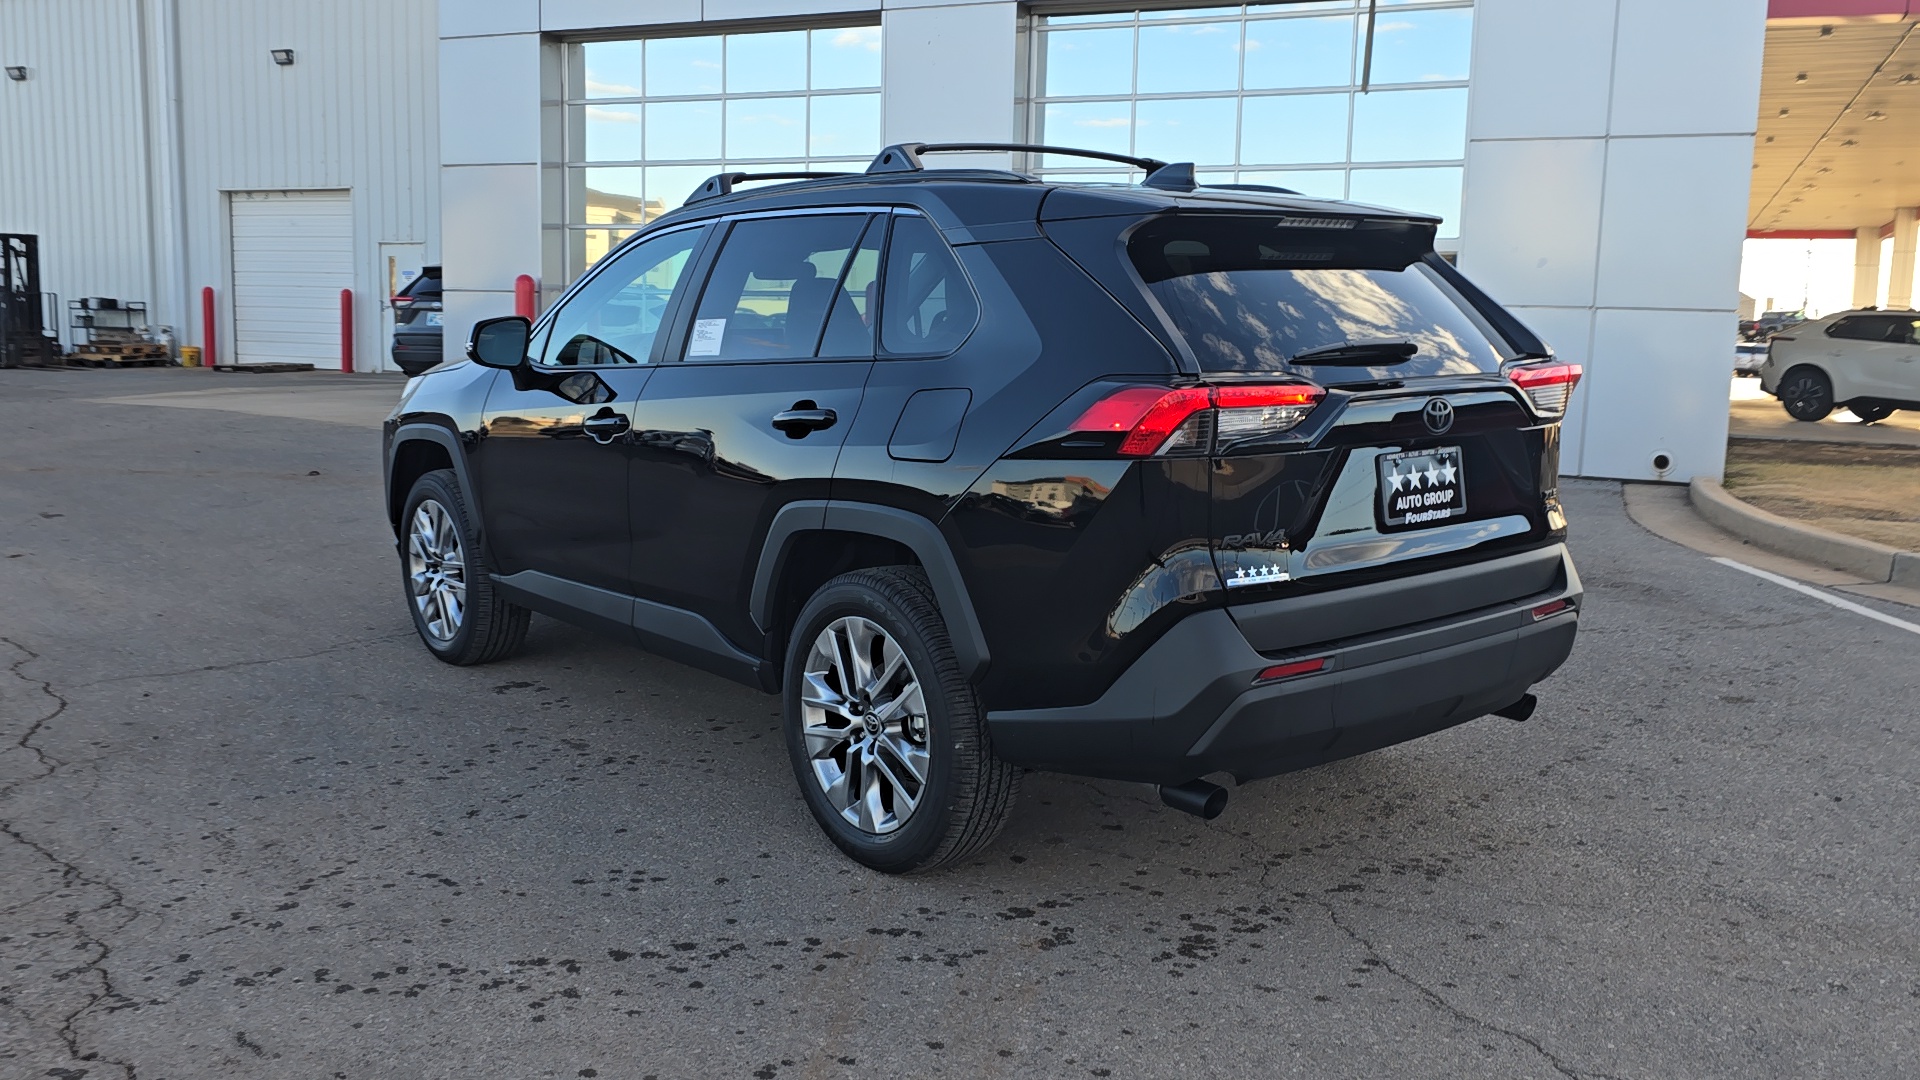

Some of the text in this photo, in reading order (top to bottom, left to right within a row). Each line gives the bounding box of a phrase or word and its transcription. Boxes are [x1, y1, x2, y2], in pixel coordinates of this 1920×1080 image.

[1396, 489, 1454, 511] AUTO GROUP
[1221, 528, 1286, 549] RAV4
